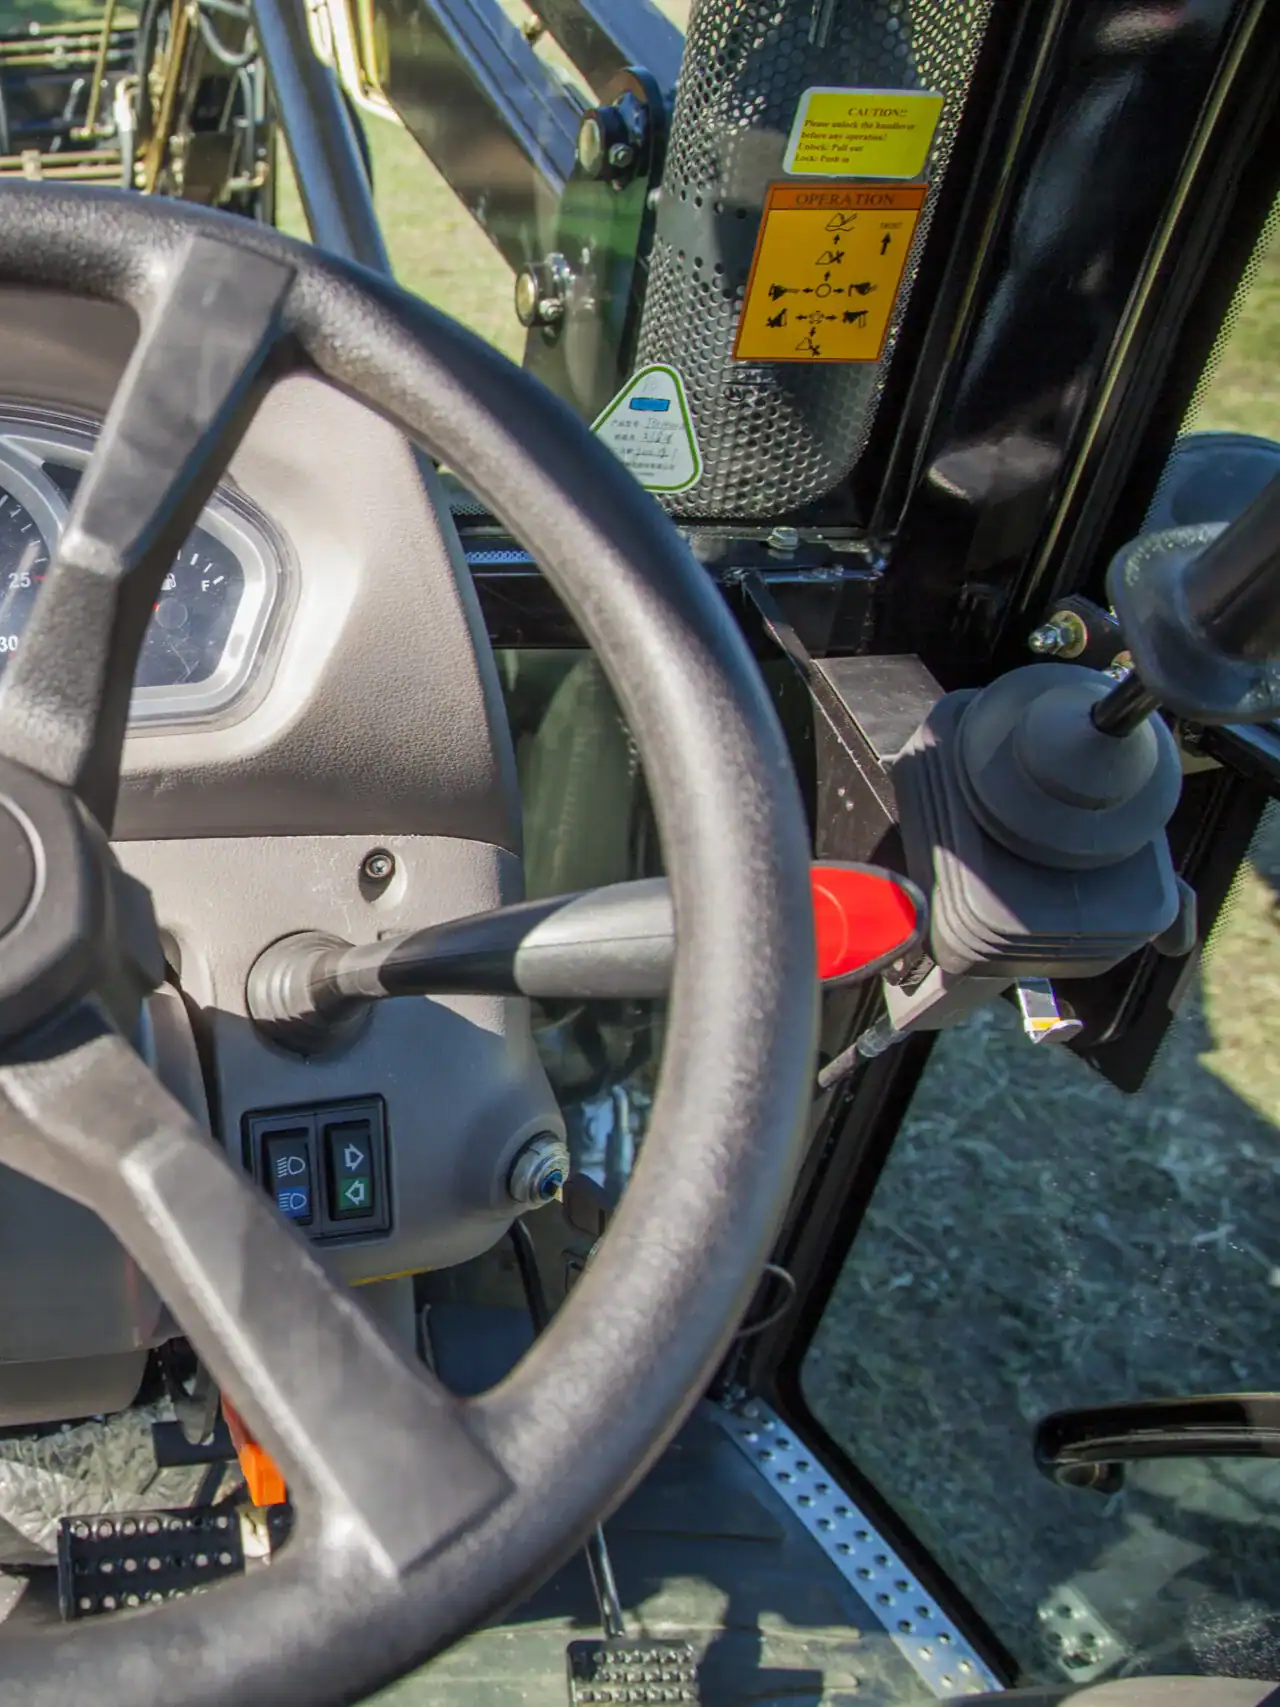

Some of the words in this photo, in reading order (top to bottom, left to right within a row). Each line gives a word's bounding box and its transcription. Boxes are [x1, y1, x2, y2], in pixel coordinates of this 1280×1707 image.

[804, 119, 830, 128] Please
[832, 120, 858, 129] unlock
[860, 121, 874, 130] the
[801, 131, 827, 140] before
[831, 143, 848, 152] Pull
[796, 193, 894, 205] OPERATION
[8, 571, 32, 589] 25
[201, 580, 210, 592] F
